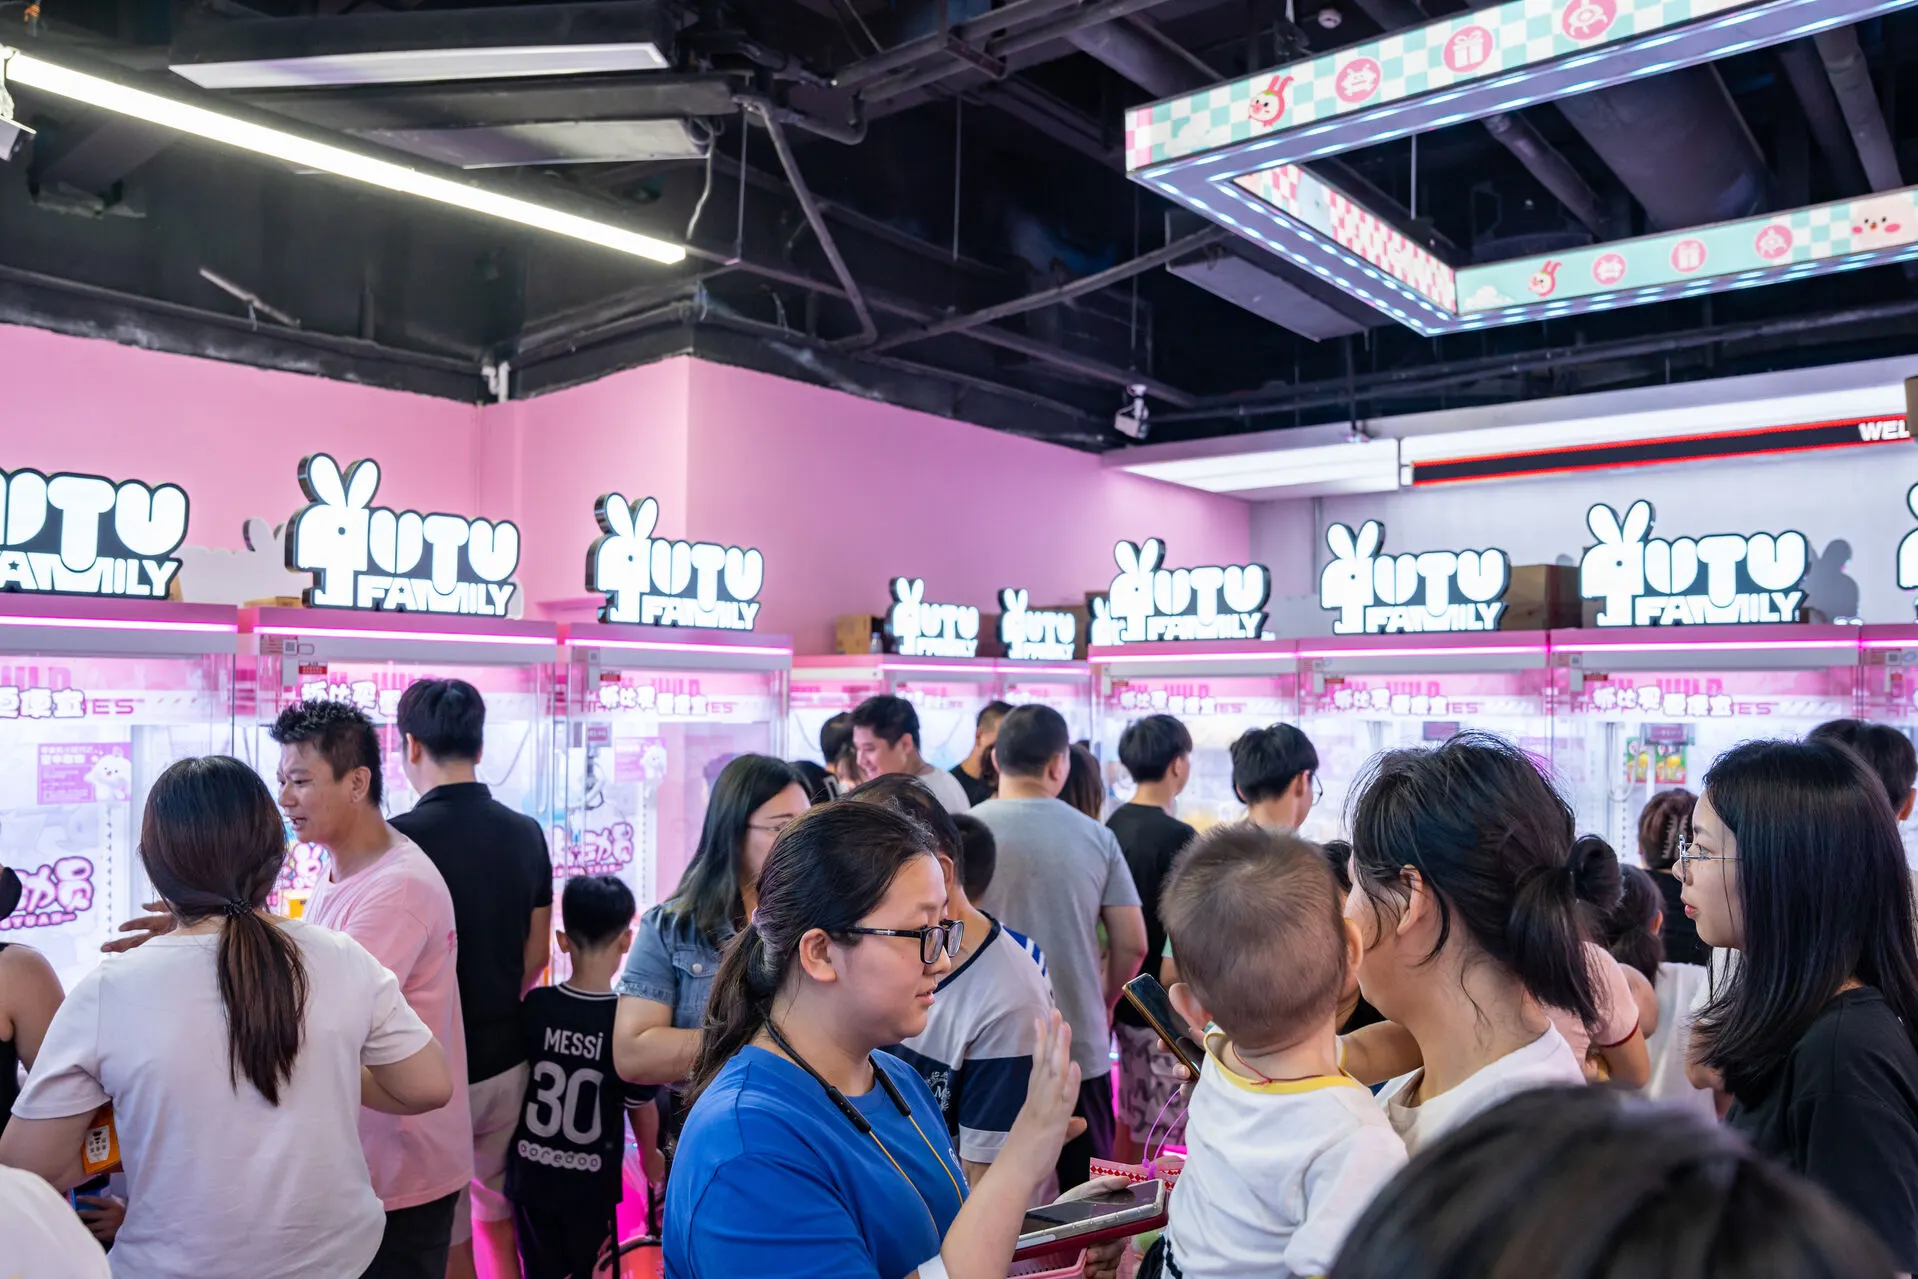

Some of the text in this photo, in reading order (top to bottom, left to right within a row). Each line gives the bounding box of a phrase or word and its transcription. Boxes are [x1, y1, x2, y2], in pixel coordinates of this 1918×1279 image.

[1858, 419, 1910, 441] WEL
[357, 575, 515, 616] FAMILY
[641, 594, 761, 630] FAMILY
[1635, 591, 1803, 626] FAMILY
[1365, 602, 1503, 634] FAMILY
[525, 1060, 604, 1145] 30
